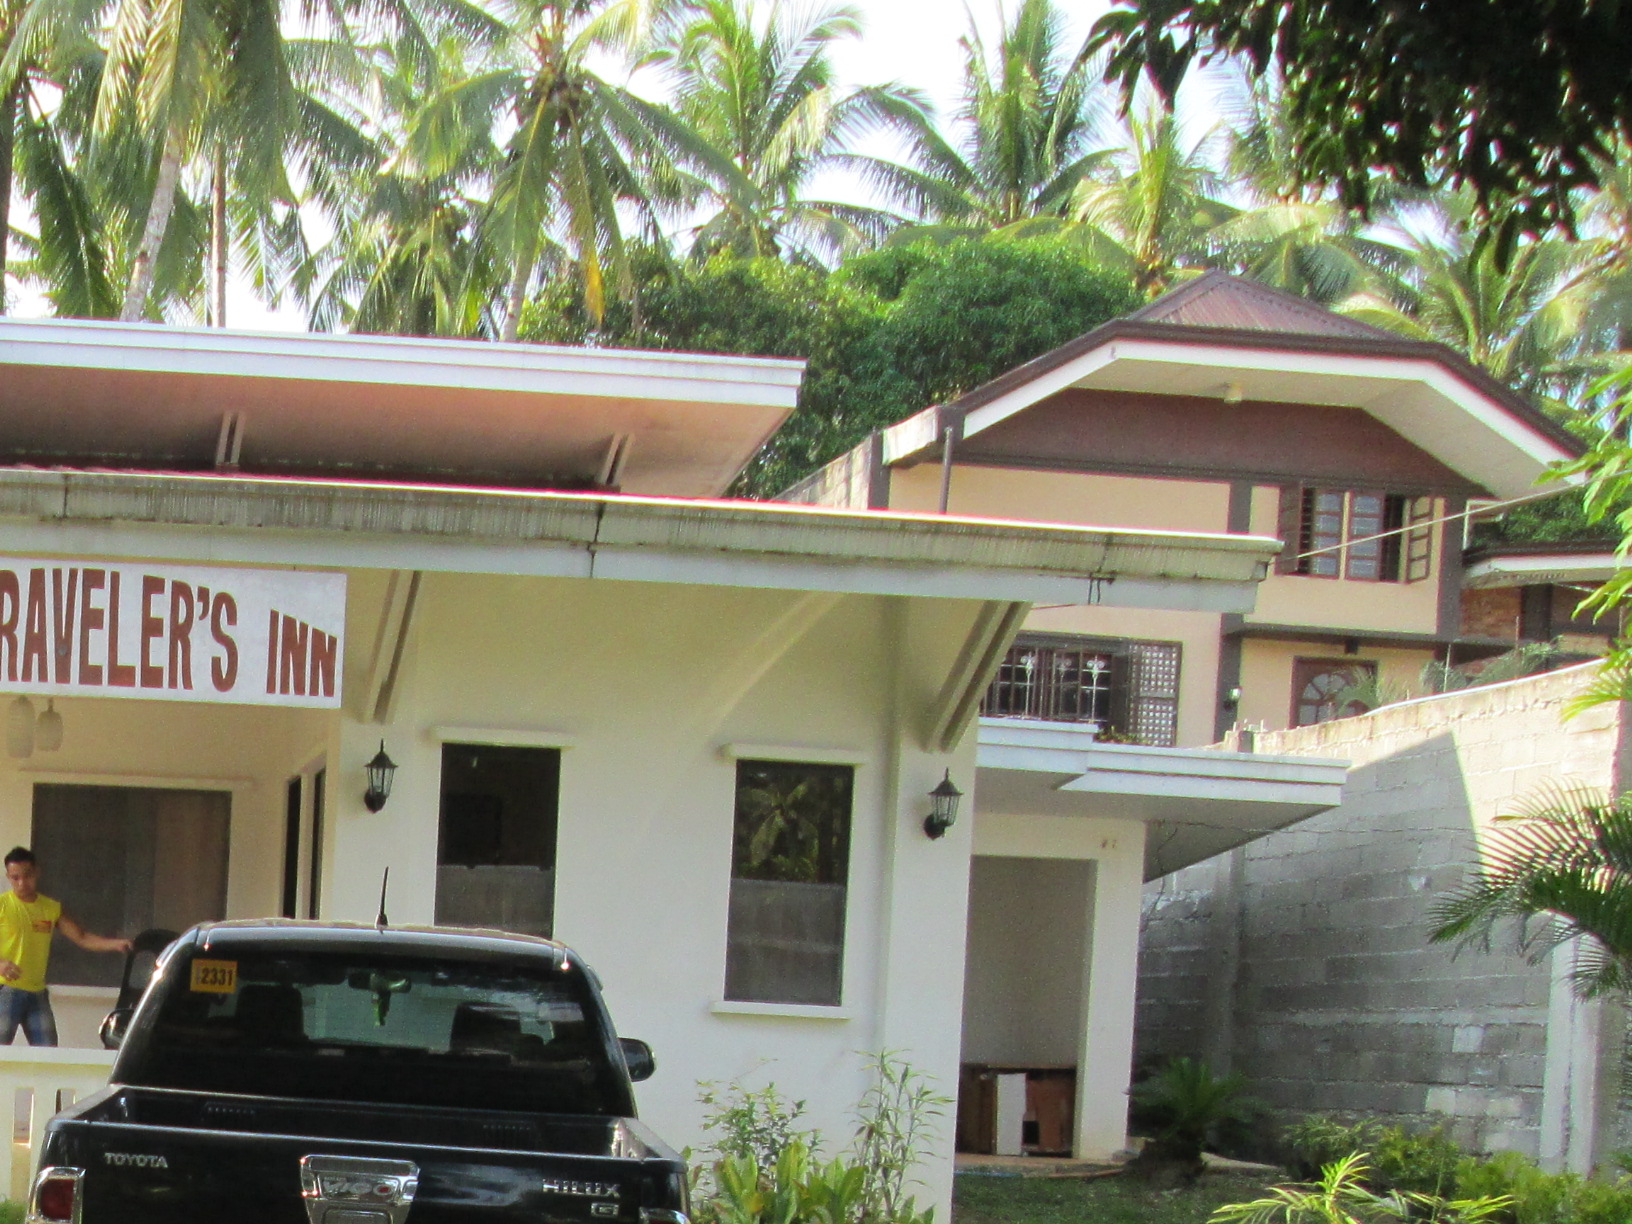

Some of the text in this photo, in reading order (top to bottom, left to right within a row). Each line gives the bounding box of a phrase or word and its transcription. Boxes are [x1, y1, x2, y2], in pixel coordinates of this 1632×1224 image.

[266, 609, 338, 697] INN
[200, 967, 234, 986] 2331
[104, 1152, 168, 1168] TOYOTA
[542, 1178, 621, 1198] HILUX
